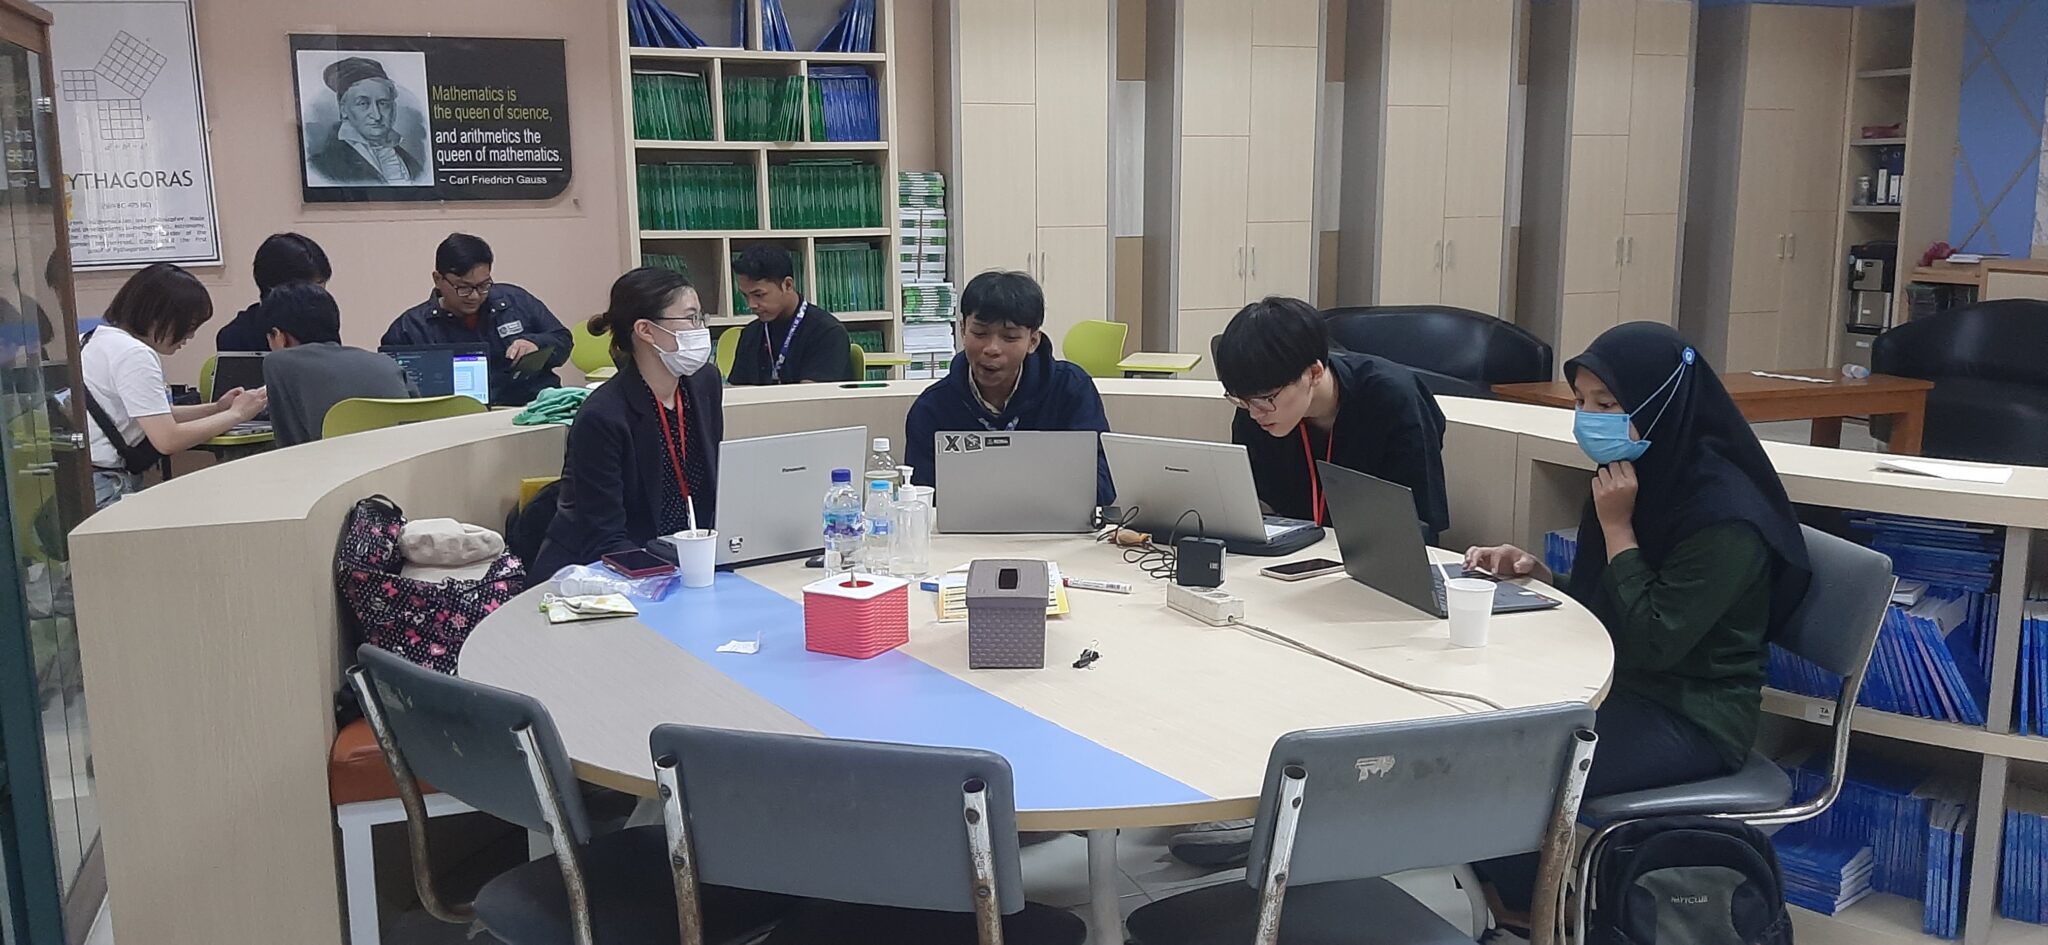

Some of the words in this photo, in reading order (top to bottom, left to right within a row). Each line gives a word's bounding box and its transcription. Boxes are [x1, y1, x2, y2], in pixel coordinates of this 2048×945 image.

[432, 85, 504, 102] Mathematics
[507, 86, 517, 102] is
[433, 104, 451, 120] the
[454, 106, 490, 123] queen
[493, 104, 504, 120] of
[507, 104, 553, 122] science,
[435, 128, 457, 144] and
[460, 128, 521, 144] arithmetics
[524, 128, 542, 144] the
[436, 149, 473, 166] queen
[475, 146, 487, 162] of
[489, 146, 563, 162] mathematics.
[63, 170, 194, 191] YTHAGORAS
[449, 175, 470, 185] Carl
[472, 174, 514, 185] Friedrich
[516, 174, 548, 185] Gauss
